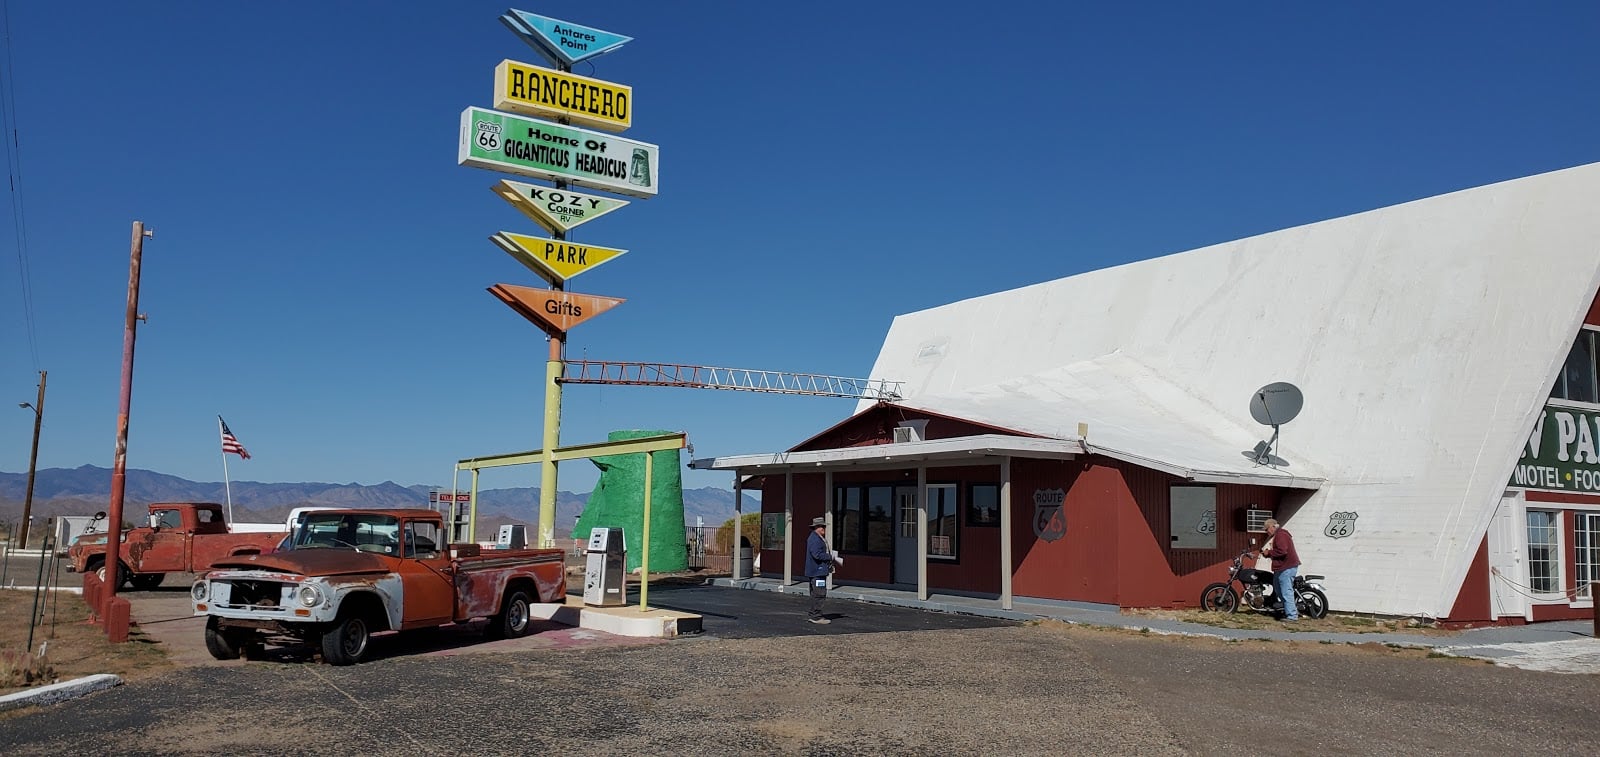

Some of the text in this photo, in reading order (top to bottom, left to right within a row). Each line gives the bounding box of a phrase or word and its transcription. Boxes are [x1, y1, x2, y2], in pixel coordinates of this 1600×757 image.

[553, 25, 596, 42] Antares
[560, 37, 588, 51] Point
[511, 69, 627, 119] RANCHERO
[480, 132, 497, 147] 66
[528, 127, 607, 153] Home Of
[504, 139, 627, 179] GIGANTICUS HEADICUS
[531, 188, 600, 209] KOZY
[545, 243, 587, 265] PARK
[545, 300, 582, 317] Gifts
[1514, 464, 1564, 488] MOTEL
[1036, 493, 1063, 503] ROUTE
[1038, 509, 1063, 532] 66
[1330, 525, 1347, 535] 66
